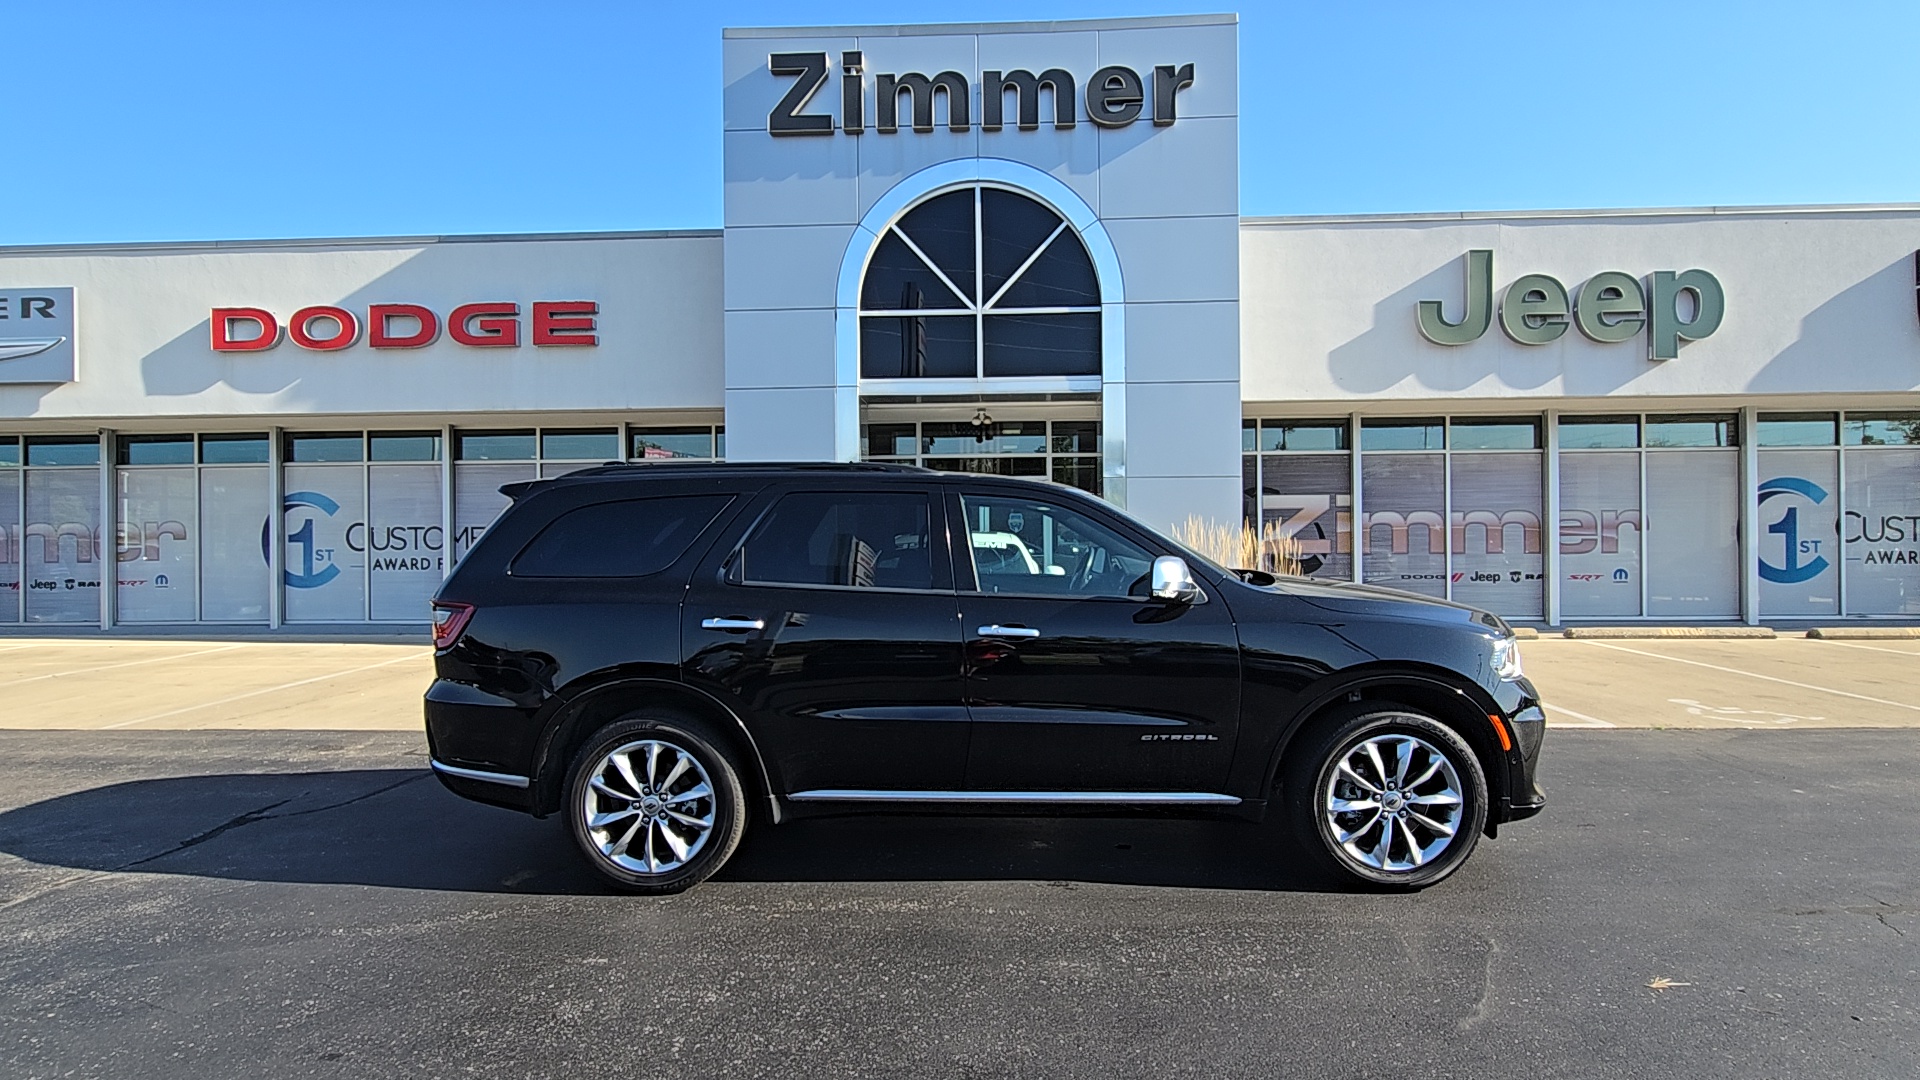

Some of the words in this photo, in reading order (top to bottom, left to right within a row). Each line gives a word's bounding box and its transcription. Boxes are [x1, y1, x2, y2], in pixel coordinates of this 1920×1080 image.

[767, 50, 1195, 137] Zimmer
[1415, 248, 1725, 361] Jeep
[210, 301, 599, 353] DODGE
[1262, 494, 1650, 555] Zimmer
[372, 557, 431, 571] AWARD
[1469, 571, 1501, 584] Jeep
[1567, 574, 1604, 582] SRT
[30, 579, 57, 591] Jeep
